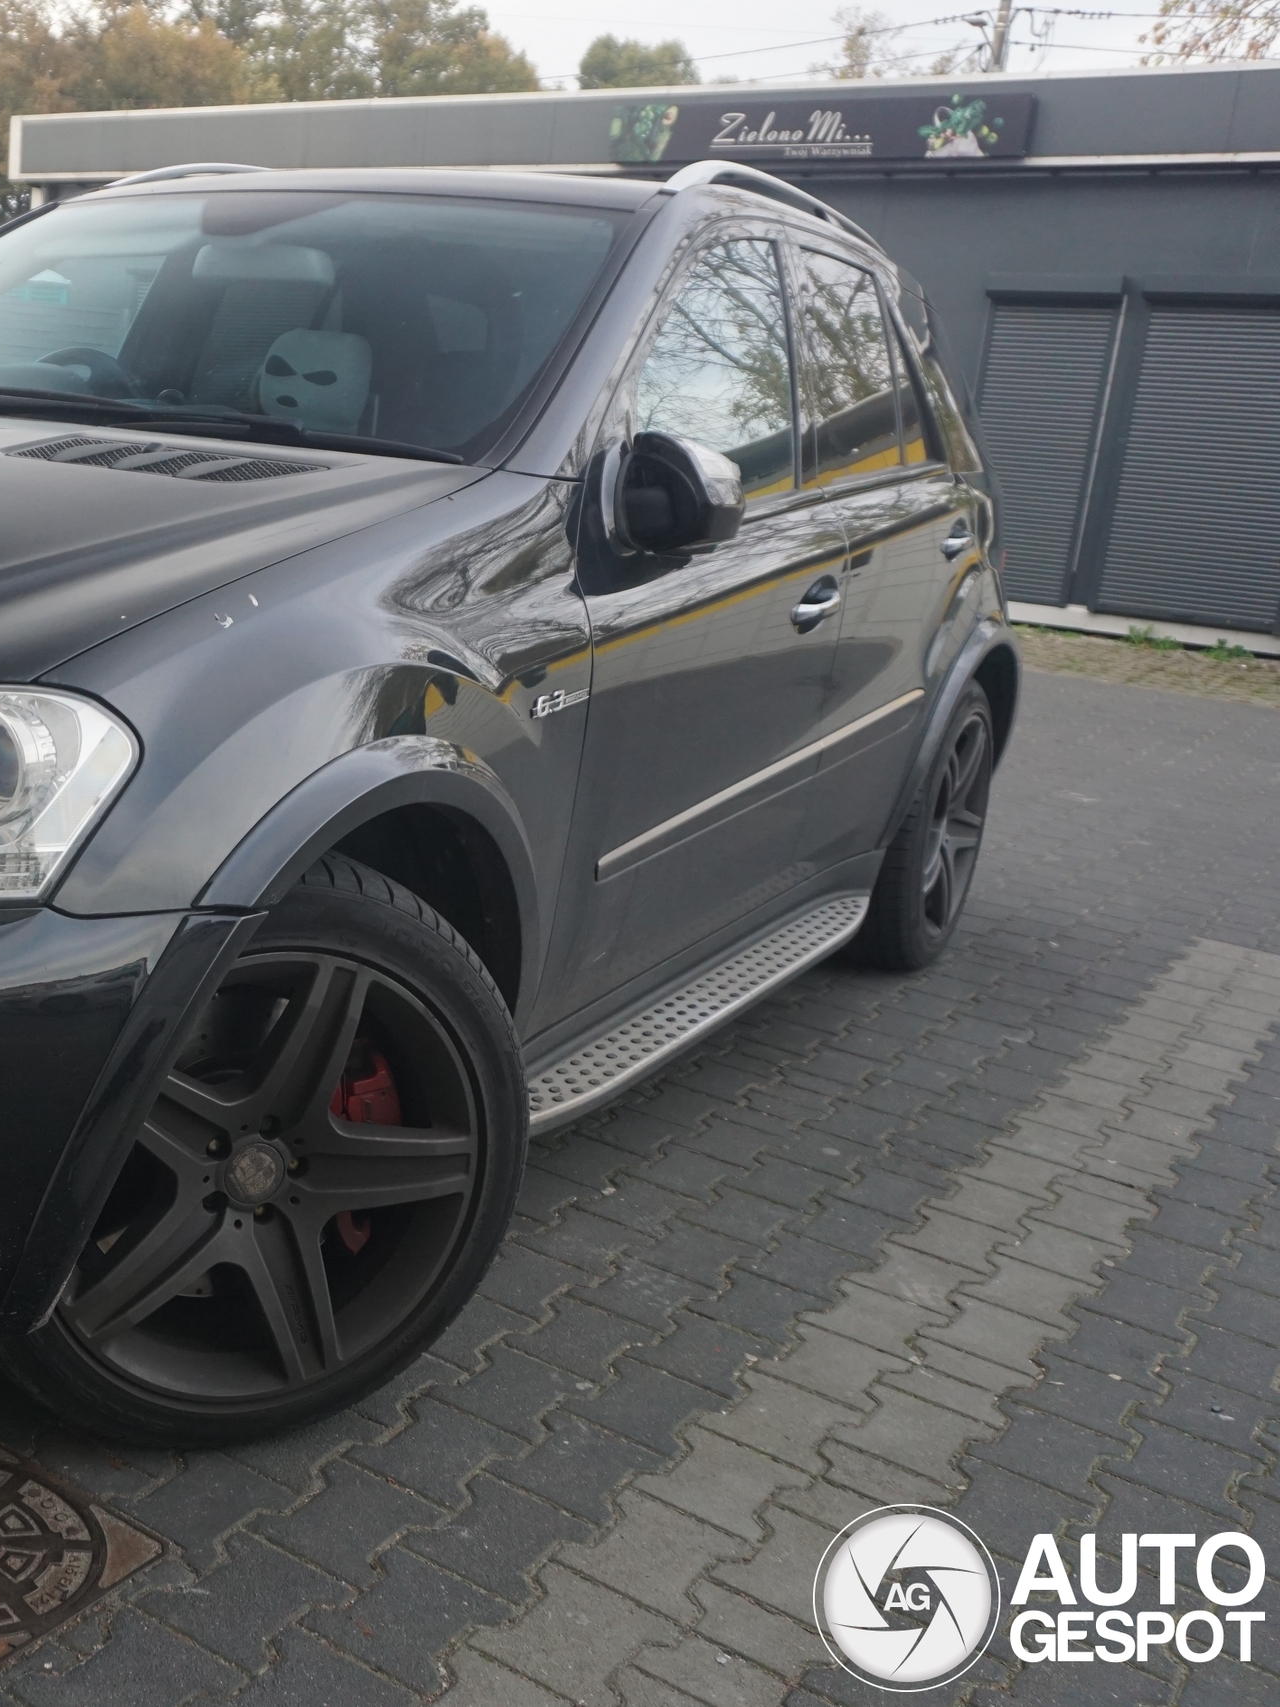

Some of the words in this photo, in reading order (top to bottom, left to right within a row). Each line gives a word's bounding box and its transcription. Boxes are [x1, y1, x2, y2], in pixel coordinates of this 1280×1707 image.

[711, 111, 803, 144] Zielono
[784, 147, 808, 156] Twój
[811, 146, 872, 156] Warzywniak
[537, 689, 565, 718] 6.3
